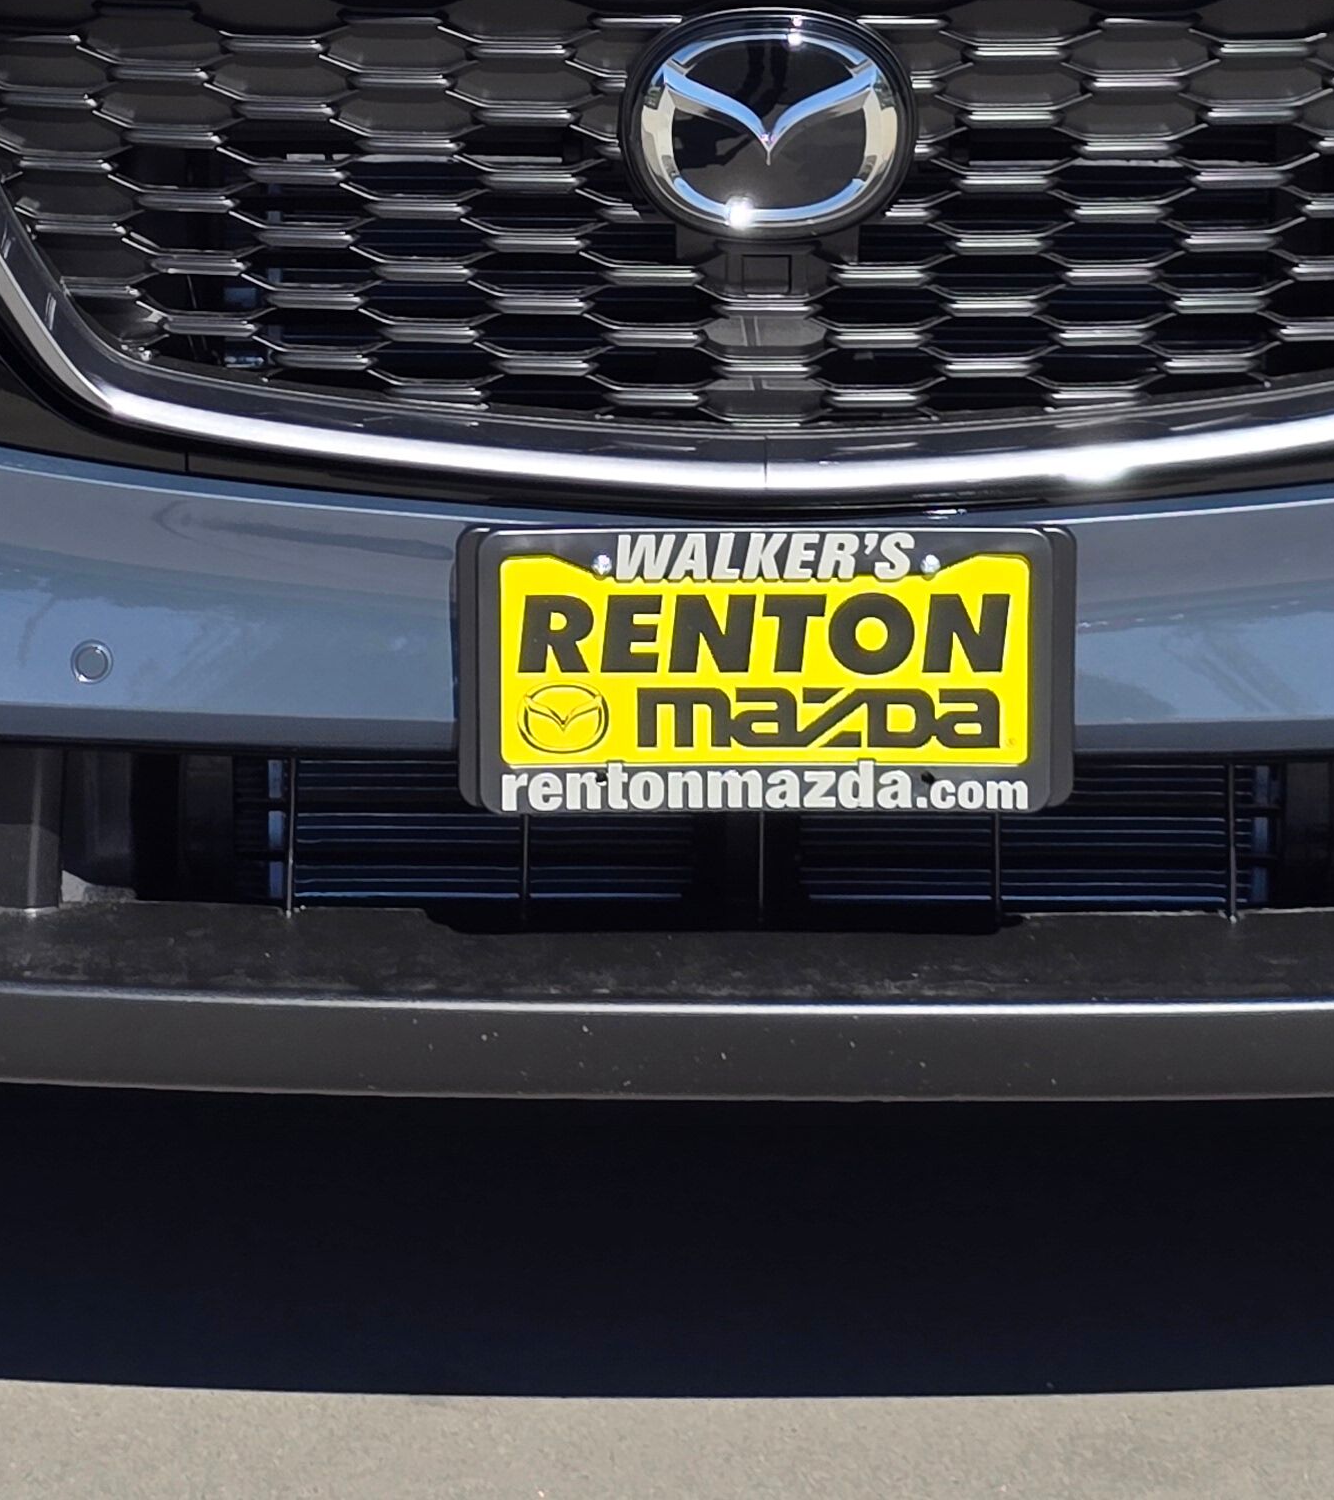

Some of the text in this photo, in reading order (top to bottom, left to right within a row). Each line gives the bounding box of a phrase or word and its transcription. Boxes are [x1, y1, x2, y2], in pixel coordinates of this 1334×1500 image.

[615, 532, 915, 582] WALKER'S
[518, 592, 1010, 675] RENTON
[501, 761, 1029, 812] rentonmazda.com
